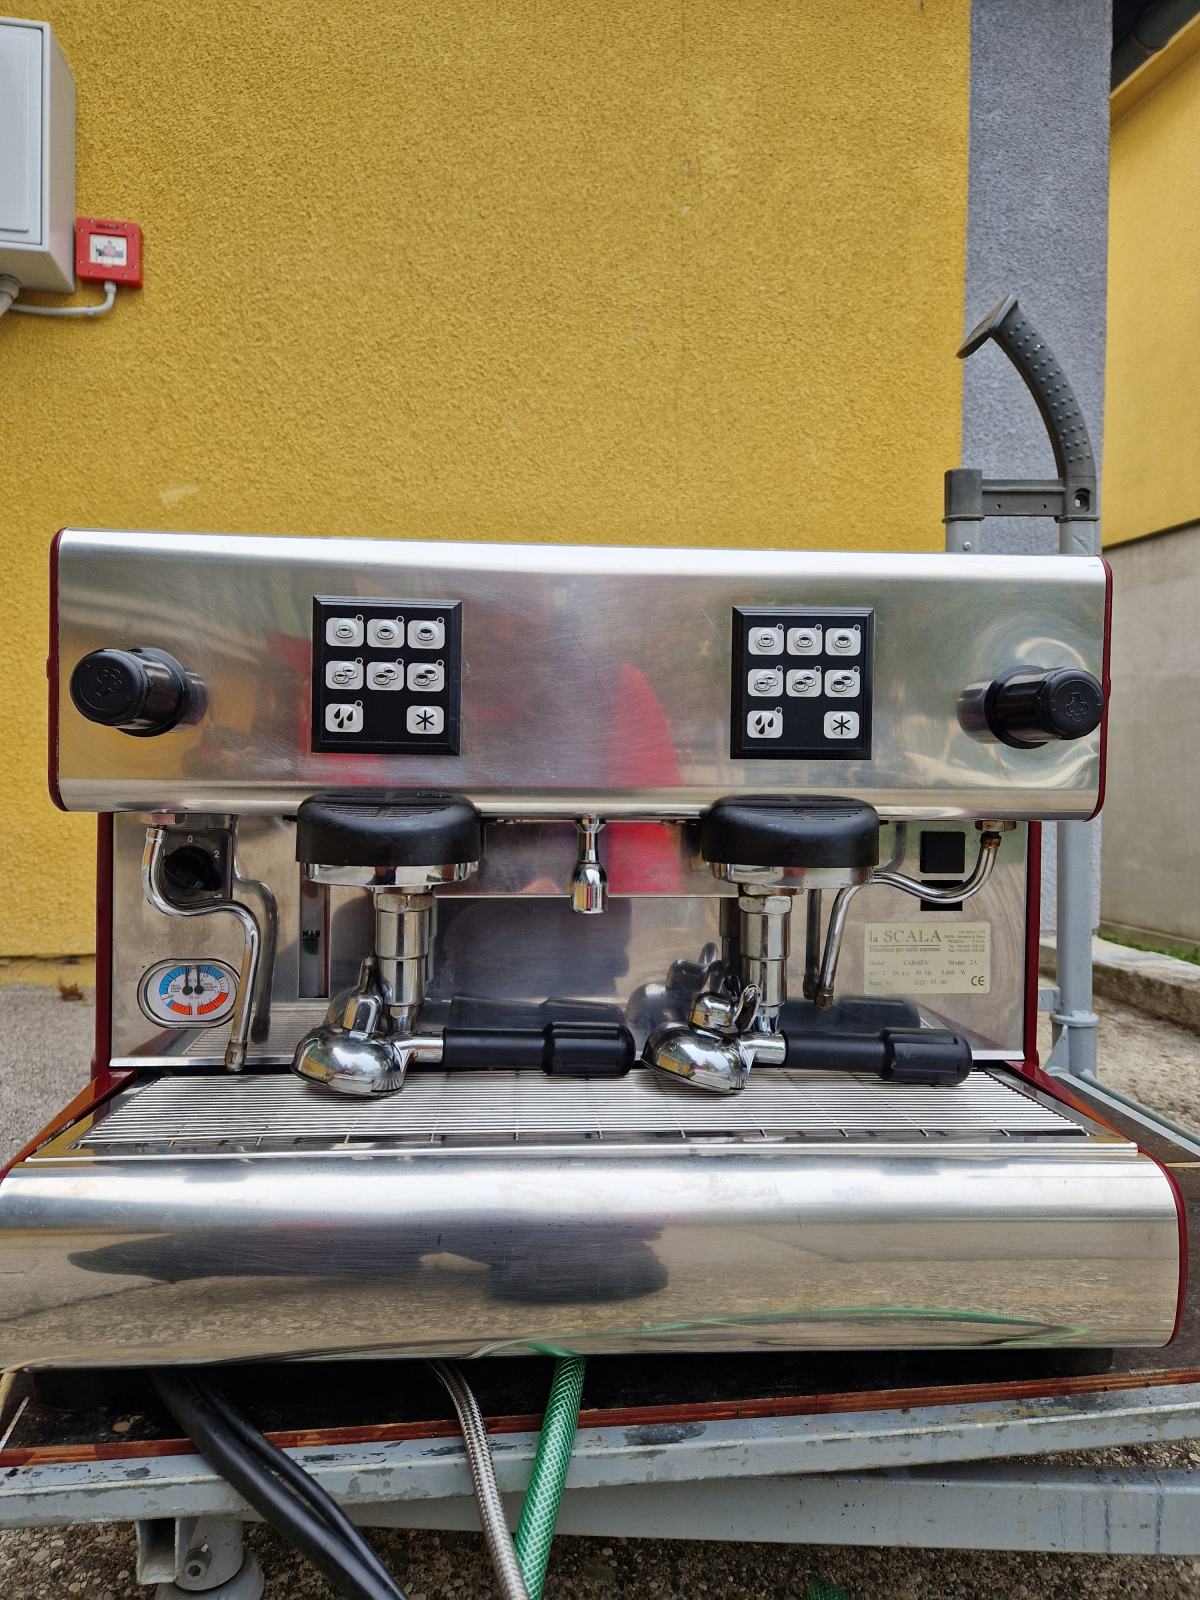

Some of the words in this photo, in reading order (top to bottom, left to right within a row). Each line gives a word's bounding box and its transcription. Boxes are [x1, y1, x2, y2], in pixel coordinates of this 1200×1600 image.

[187, 835, 193, 843] 0
[213, 850, 220, 858] 2
[883, 930, 942, 943] SCALA
